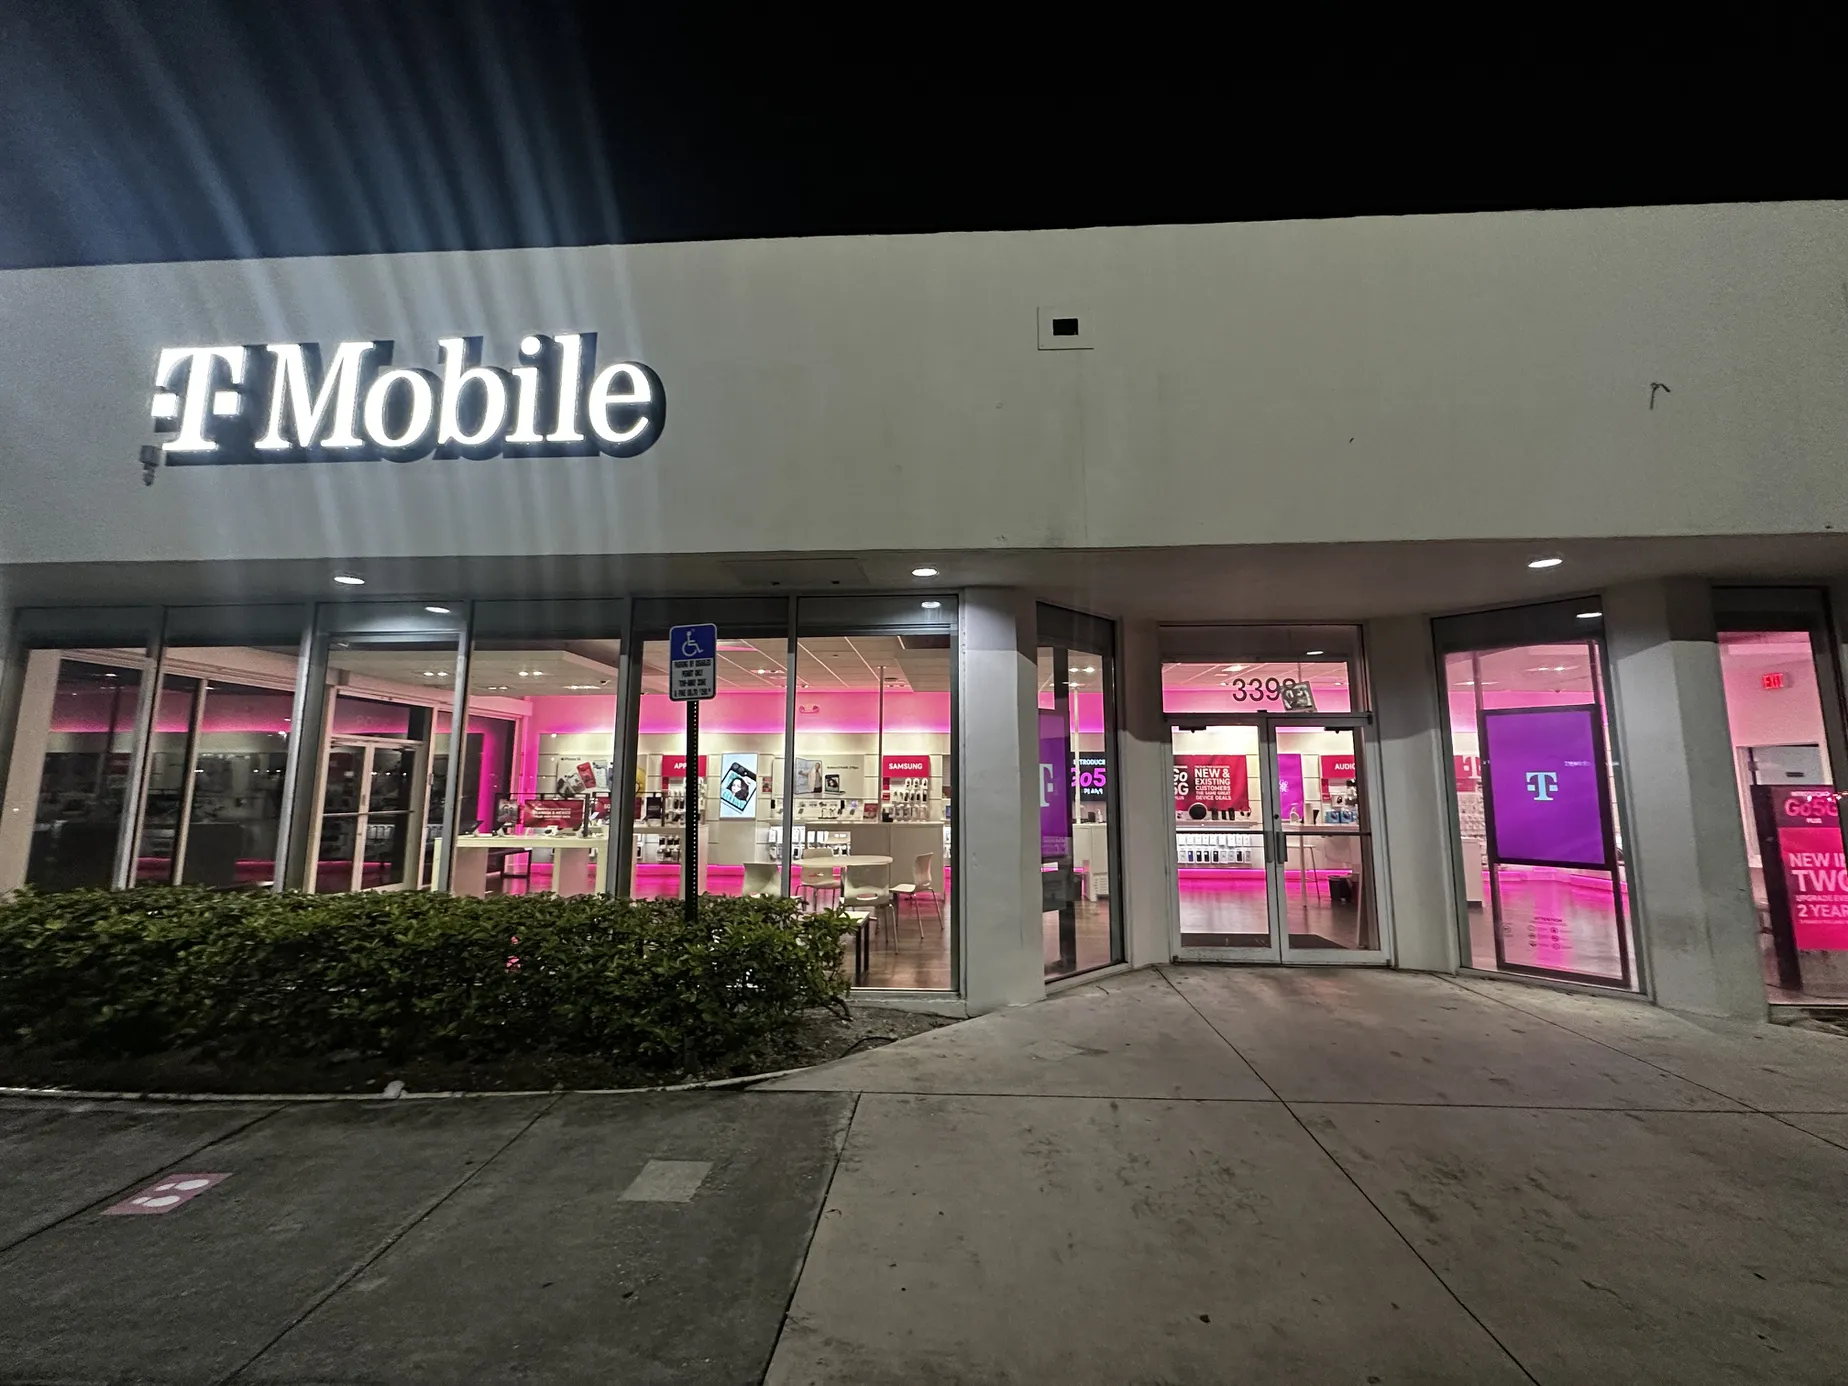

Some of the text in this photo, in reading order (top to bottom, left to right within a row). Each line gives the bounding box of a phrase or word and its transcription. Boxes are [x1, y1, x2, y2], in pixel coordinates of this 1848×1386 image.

[255, 333, 652, 451] Mobile
[1194, 768, 1230, 778] NEW &
[1788, 852, 1830, 868] NEW
[1797, 904, 1808, 917] 2
